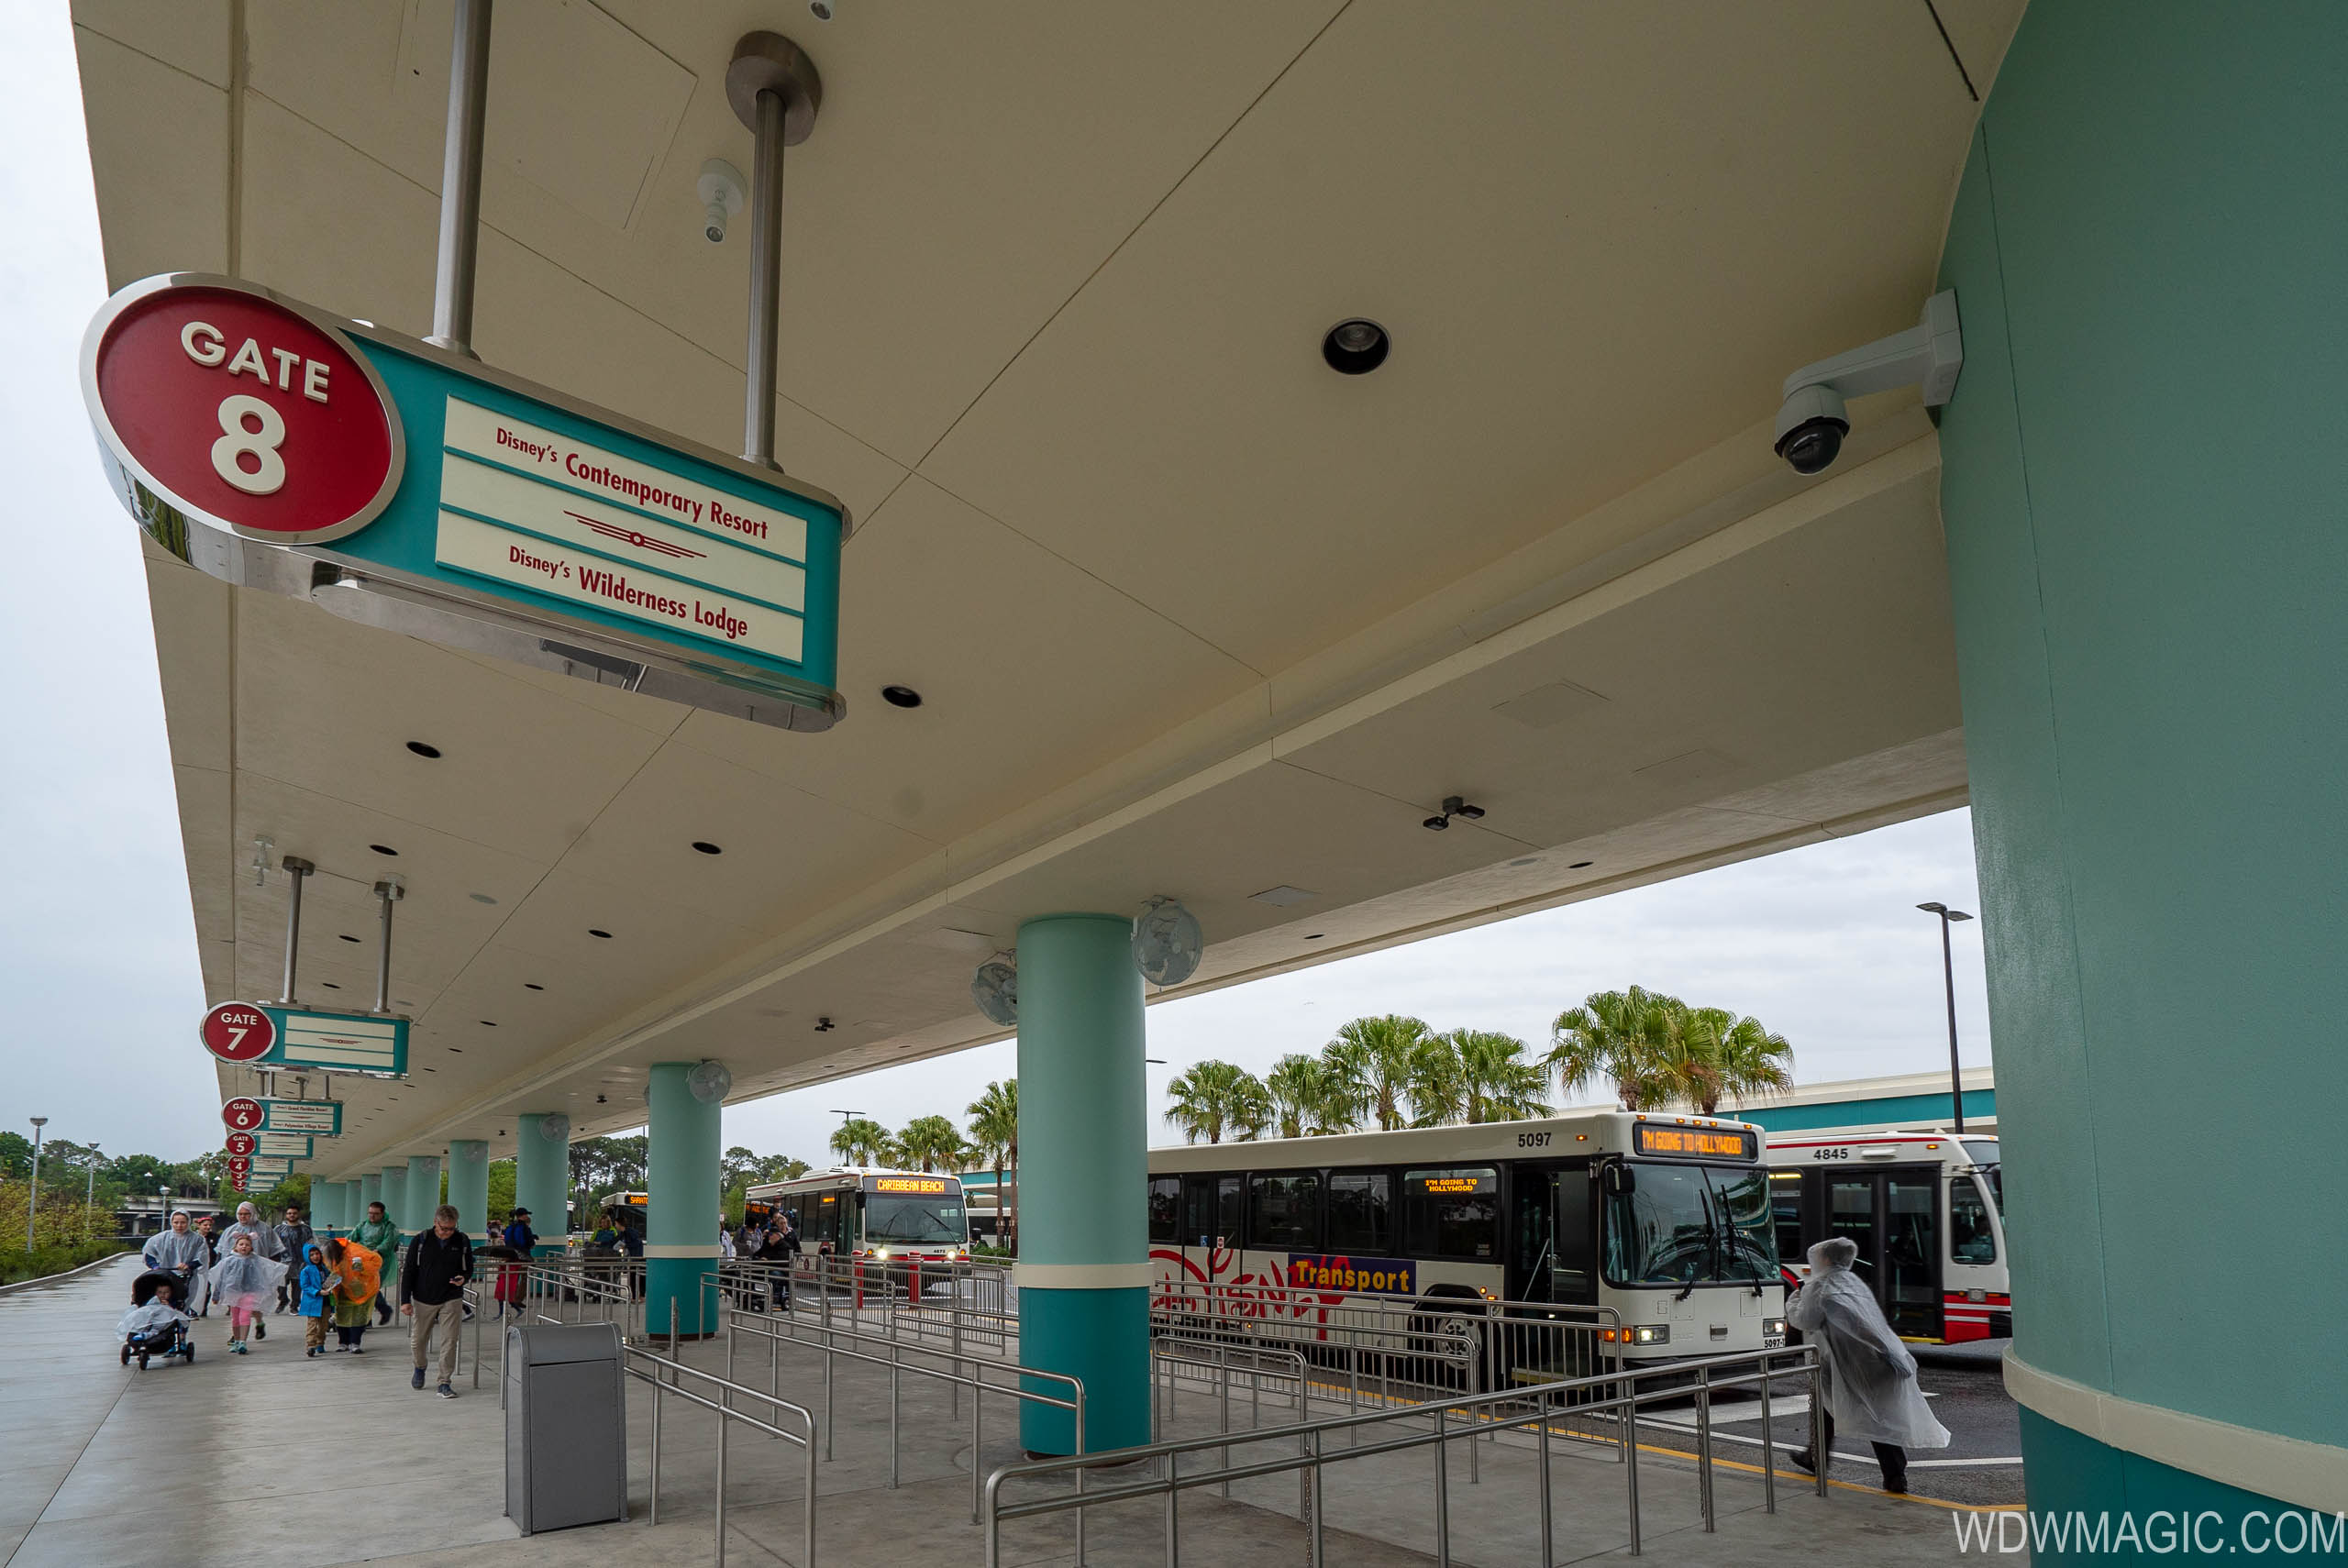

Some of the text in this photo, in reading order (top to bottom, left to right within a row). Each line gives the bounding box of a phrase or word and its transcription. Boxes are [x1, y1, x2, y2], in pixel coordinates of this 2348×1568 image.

[181, 321, 330, 403] GATE
[211, 394, 286, 495] 8
[496, 426, 769, 540] Disney's Contemporary Resort
[509, 545, 748, 640] Disney's Wilderness Lodge
[220, 1012, 258, 1026] GATE
[227, 1027, 249, 1052] 7
[232, 1102, 254, 1111] GATE
[237, 1112, 249, 1126] 6
[236, 1143, 245, 1153] 5
[1518, 1132, 1552, 1148] 5097
[1656, 1132, 1681, 1151] GOING
[1683, 1132, 1694, 1152] TO
[1695, 1134, 1743, 1154] HOLLYWOOD
[1813, 1148, 1848, 1160] 4845
[235, 1162, 242, 1170] 4
[877, 1179, 945, 1193] CARIBBEAN BEACH
[1296, 1260, 1410, 1293] Transport
